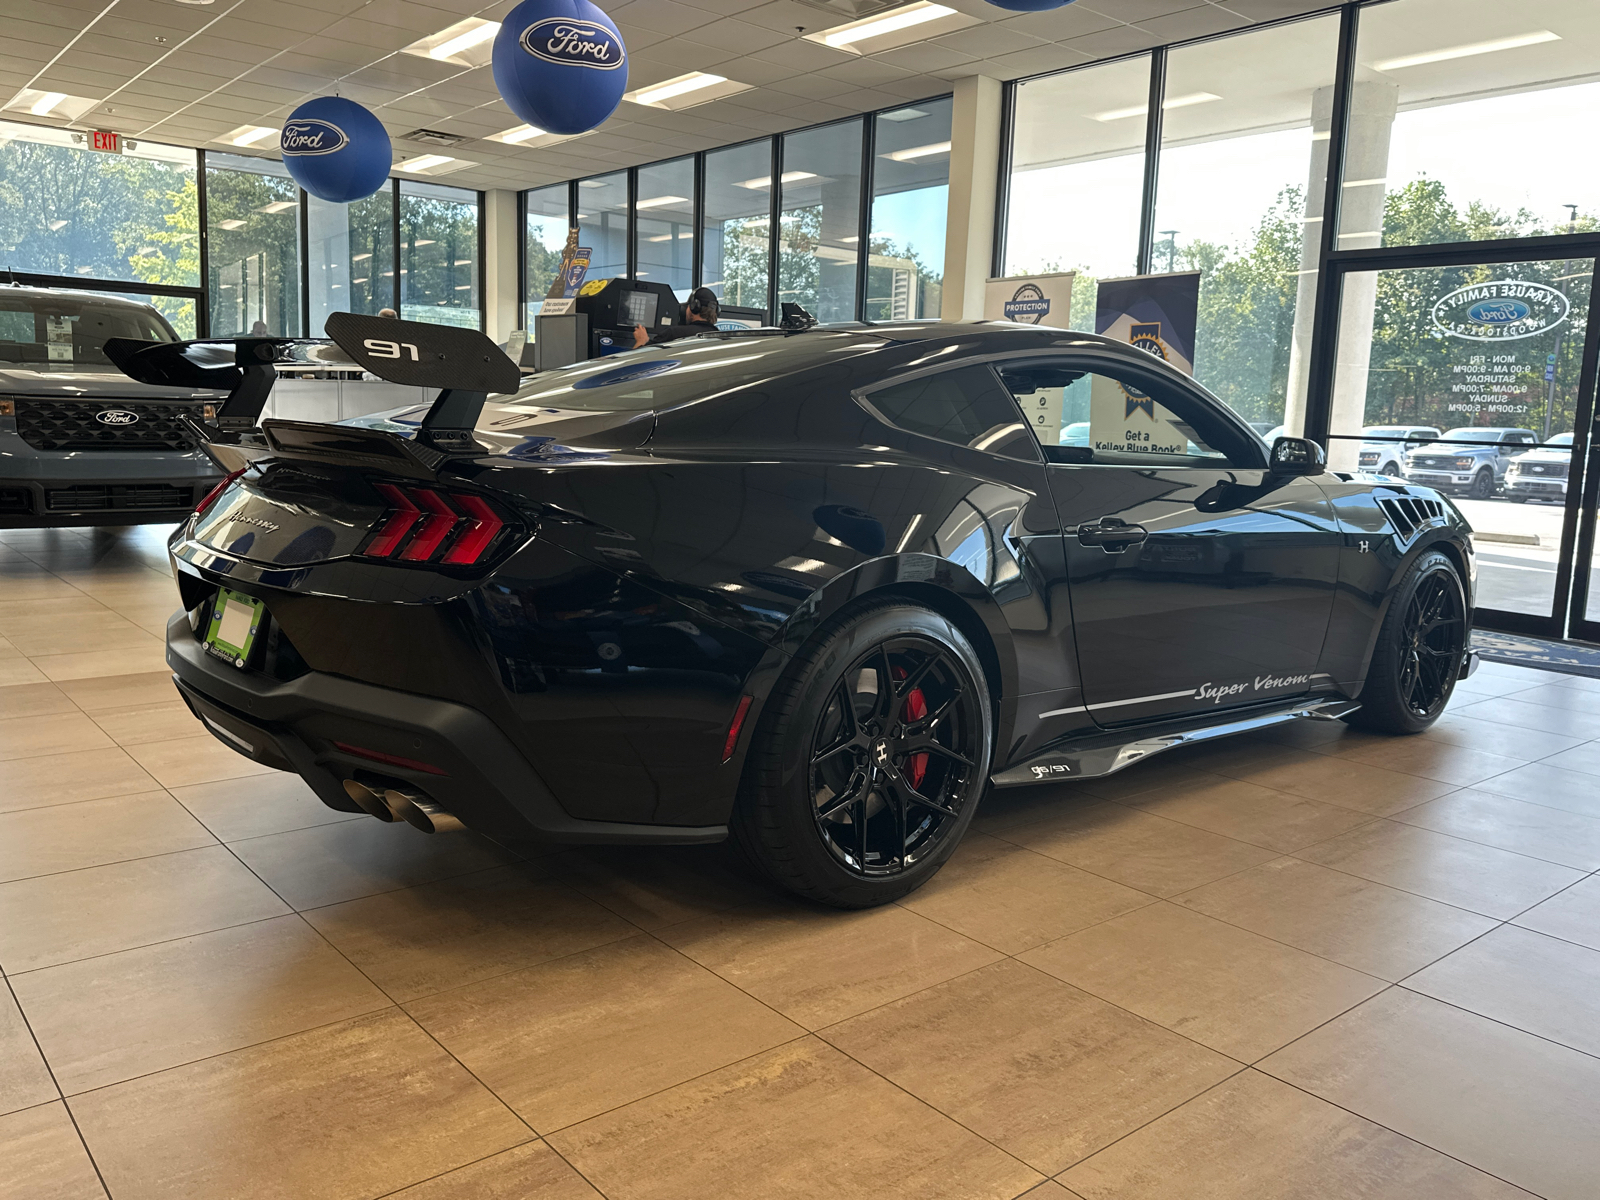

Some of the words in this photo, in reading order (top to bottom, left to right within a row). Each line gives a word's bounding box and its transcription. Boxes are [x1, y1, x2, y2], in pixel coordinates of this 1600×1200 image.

[547, 25, 610, 60] Ford
[93, 131, 118, 151] EXIT
[283, 125, 324, 148] Ford
[1006, 302, 1048, 312] PROTECTION
[363, 338, 419, 361] 91
[104, 412, 131, 423] Ford
[1125, 430, 1142, 441] Get
[1143, 433, 1150, 441] a
[1194, 682, 1249, 704] Super
[1254, 674, 1308, 691] Venom
